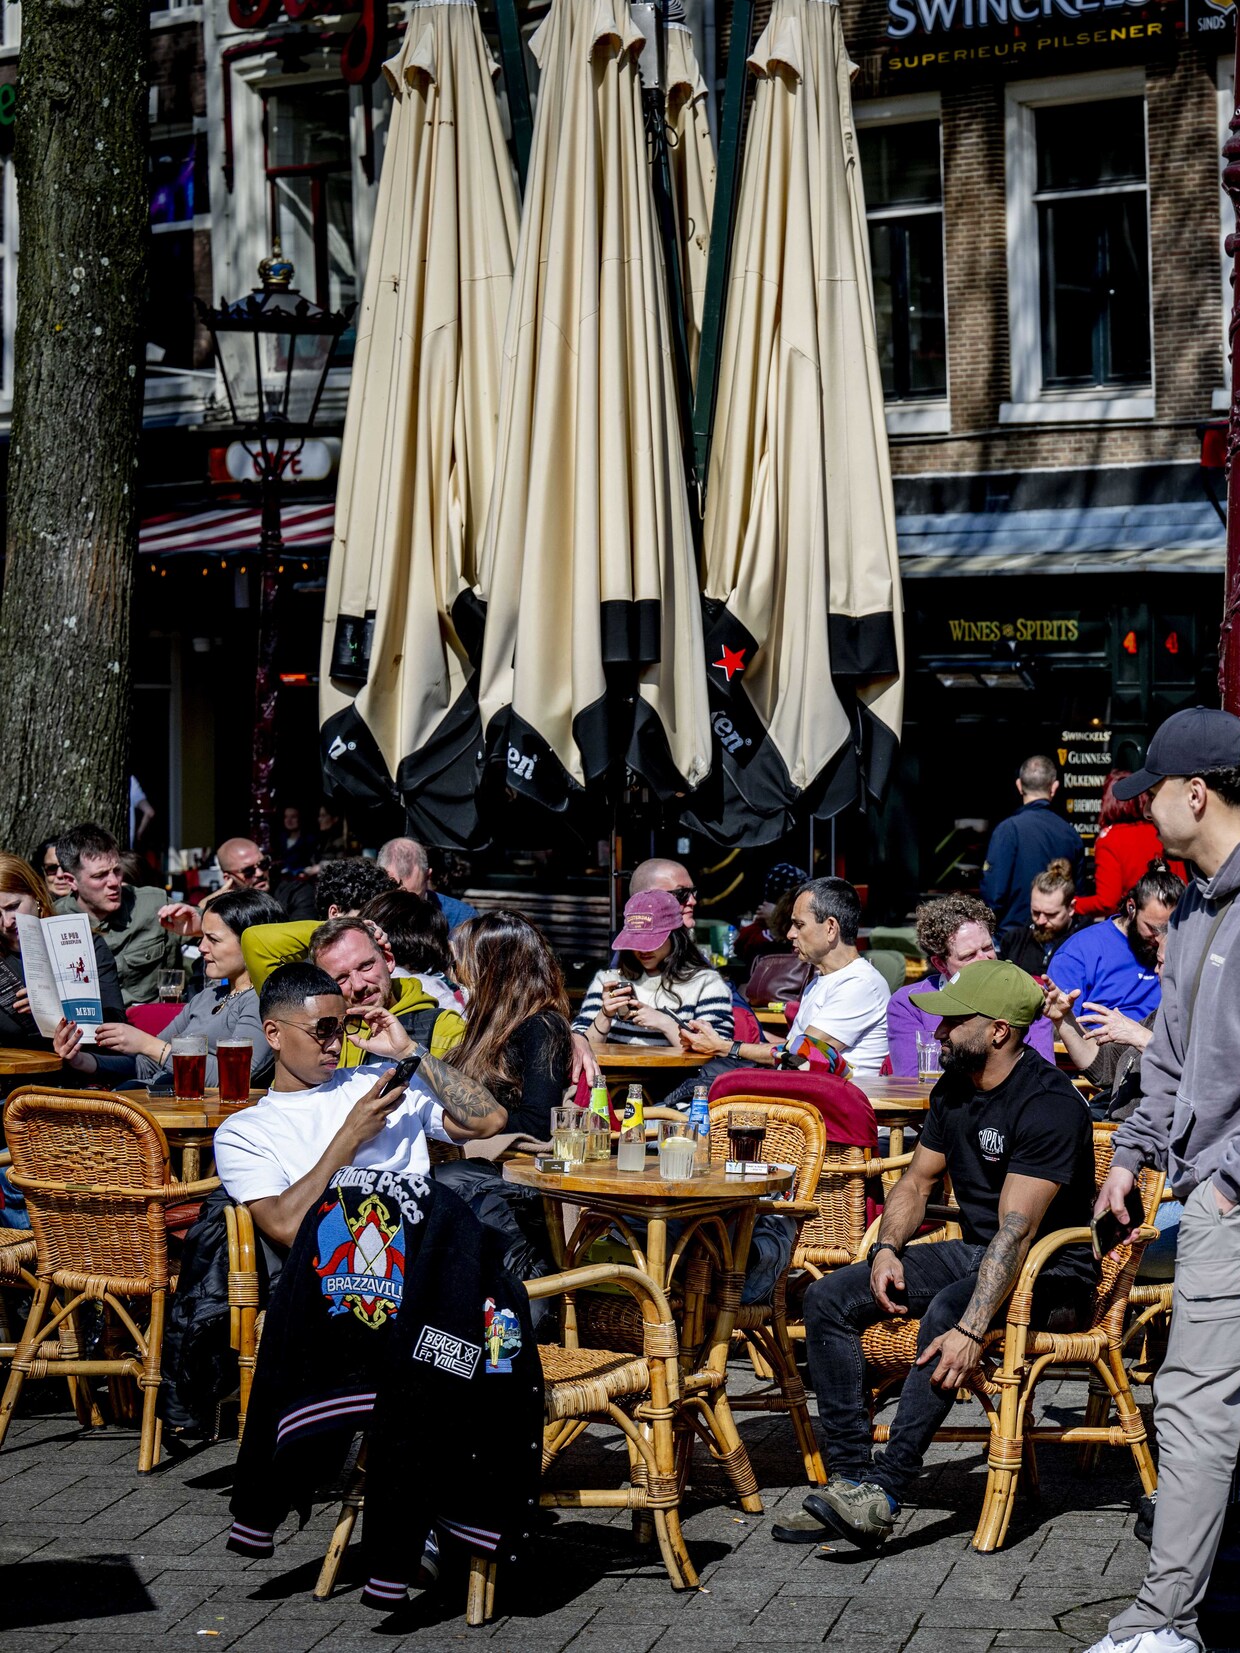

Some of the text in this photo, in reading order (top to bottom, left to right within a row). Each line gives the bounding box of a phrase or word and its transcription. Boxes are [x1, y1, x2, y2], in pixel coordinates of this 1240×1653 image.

[1197, 14, 1226, 31] SINDS
[888, 22, 1163, 70] SUPERIEUR PILSENER
[949, 619, 1000, 641] WINES
[1016, 618, 1079, 641] SPIRITS
[1068, 750, 1112, 764] GUINNESS
[1063, 773, 1106, 788] KILKENNY
[75, 1007, 96, 1016] MENU
[424, 1330, 462, 1360] BRAZZA
